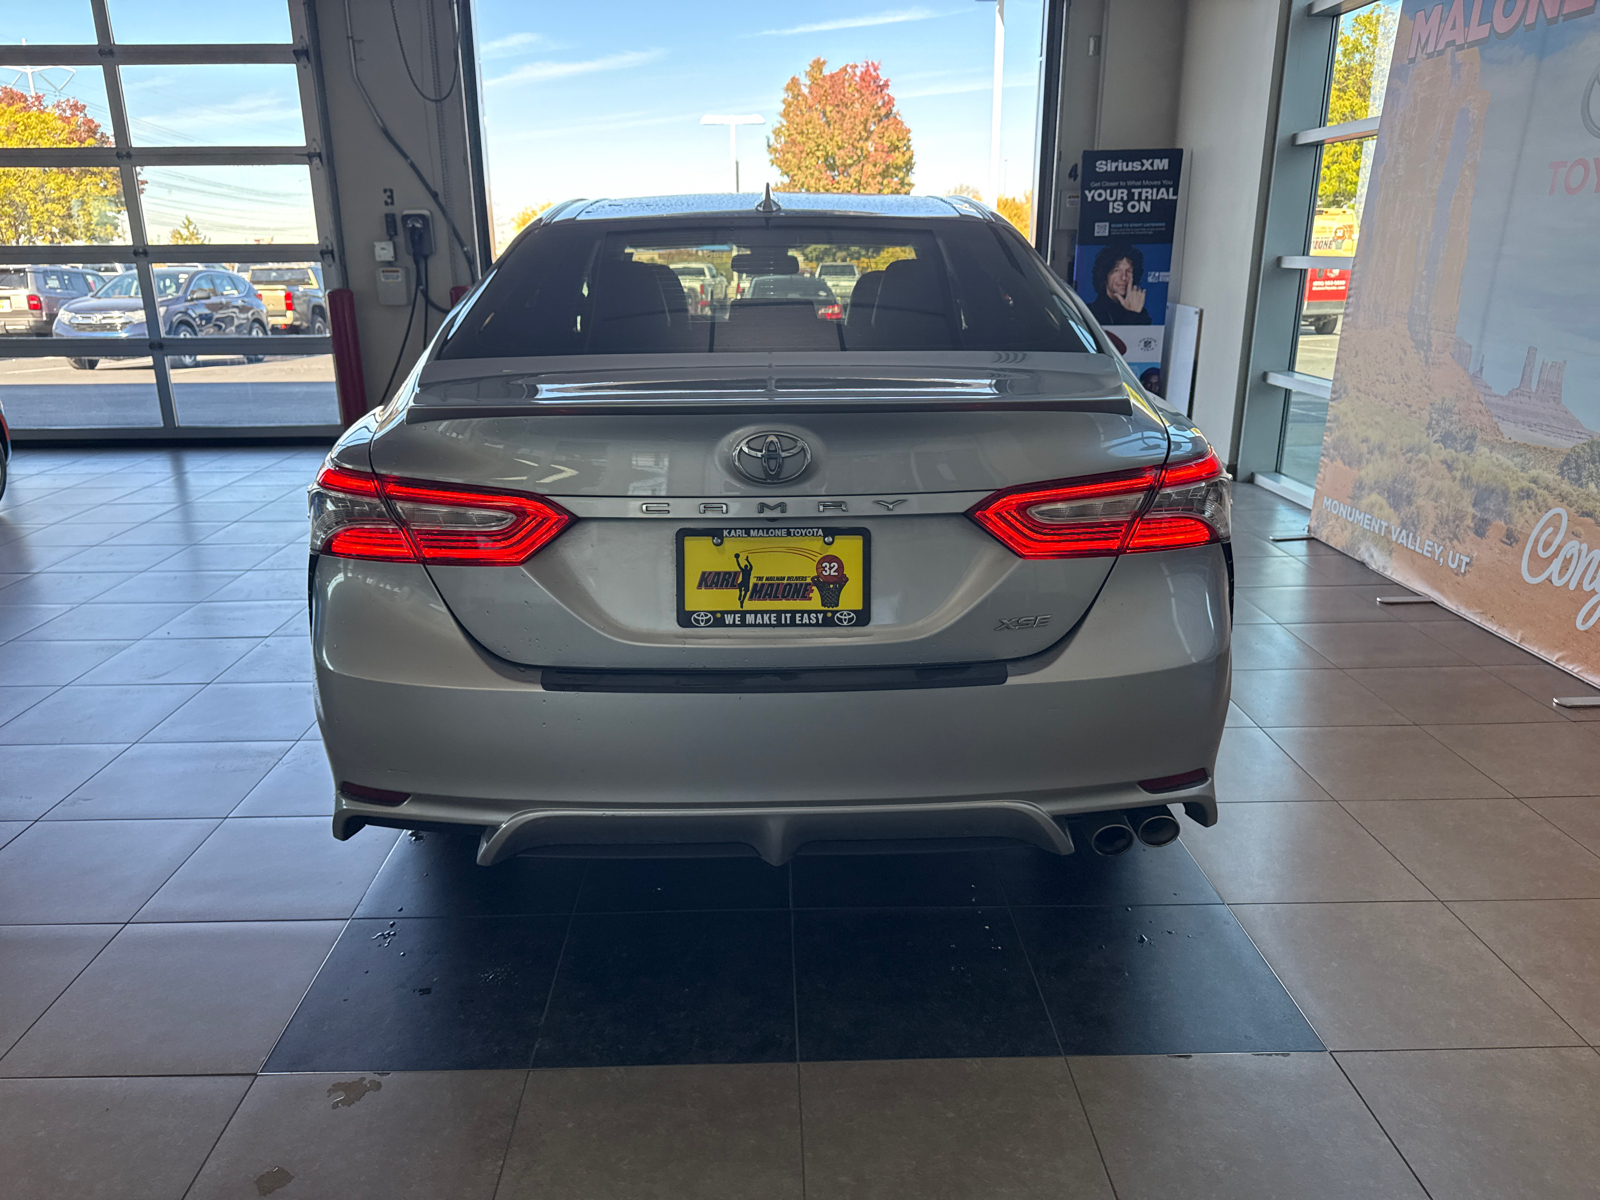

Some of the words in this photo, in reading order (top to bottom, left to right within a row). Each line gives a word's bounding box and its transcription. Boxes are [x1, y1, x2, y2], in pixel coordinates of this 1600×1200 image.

[1068, 163, 1078, 182] 4
[1095, 158, 1169, 172] SiriusXM
[383, 188, 395, 206] 3
[1084, 188, 1128, 202] YOUR
[1131, 187, 1178, 200] TRIAL
[1108, 202, 1124, 214] IS
[1127, 201, 1151, 213] ON
[641, 498, 908, 514] CAMRY
[723, 529, 748, 537] KARL
[750, 529, 788, 537] MALONE
[790, 528, 824, 537] TOYOTA
[1322, 496, 1388, 536] MONUMENT
[1391, 525, 1444, 567] VALLEY,
[1448, 550, 1470, 573] UT
[822, 562, 838, 576] 32
[696, 571, 740, 589] KARL
[748, 582, 814, 601] MALONE
[724, 614, 741, 624] WE
[746, 614, 777, 624] MAKE
[782, 613, 792, 624] IT
[796, 613, 824, 624] EASY
[994, 614, 1052, 630] XSE
